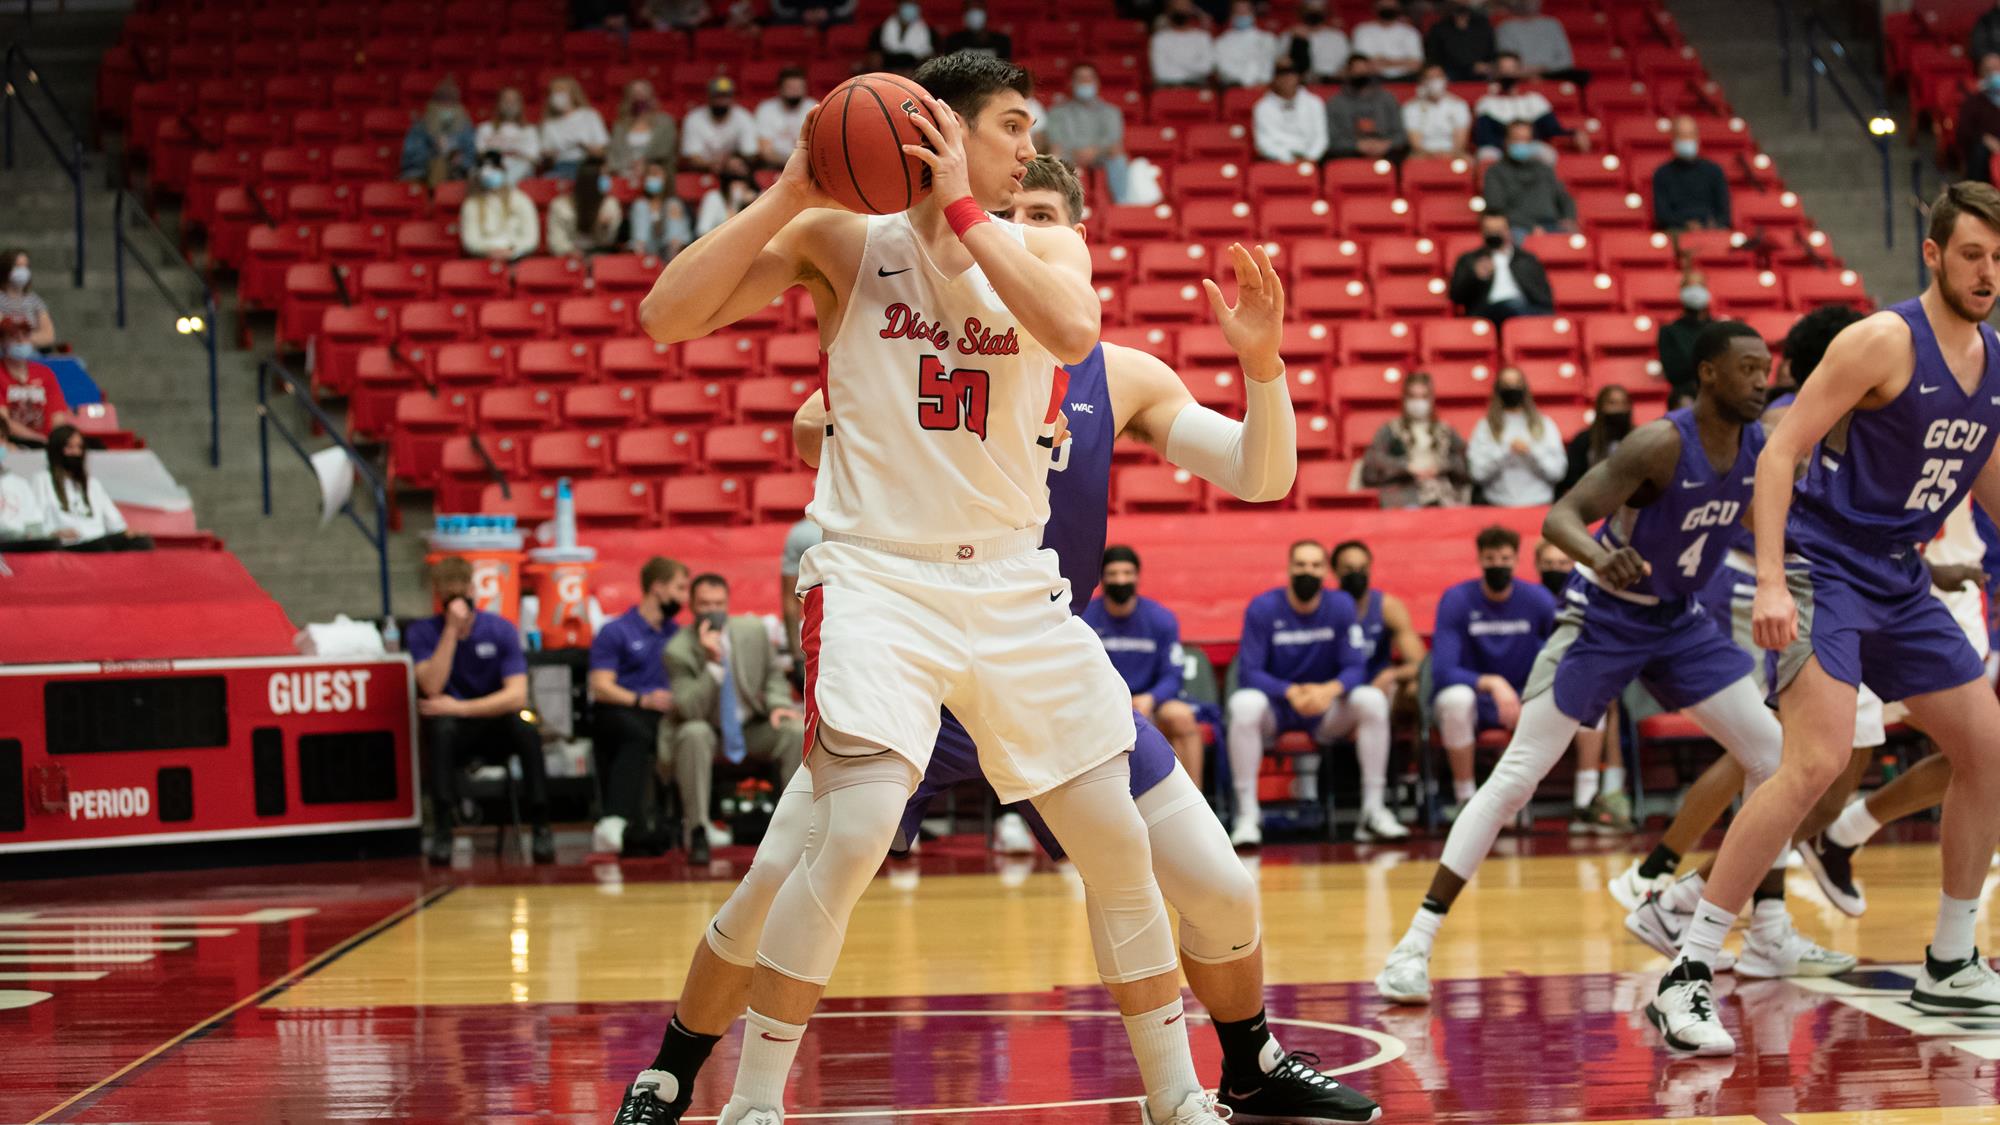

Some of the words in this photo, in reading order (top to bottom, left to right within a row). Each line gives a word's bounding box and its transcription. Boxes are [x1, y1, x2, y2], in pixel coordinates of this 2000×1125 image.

[917, 354, 990, 442] 50
[1071, 402, 1094, 414] WAC
[1923, 418, 1988, 452] GCU
[1903, 458, 1964, 513] 25
[1681, 500, 1740, 531] GCU
[1677, 532, 1709, 577] 4
[558, 575, 583, 602] G
[268, 670, 371, 715] GUEST
[68, 786, 150, 821] PERIOD
